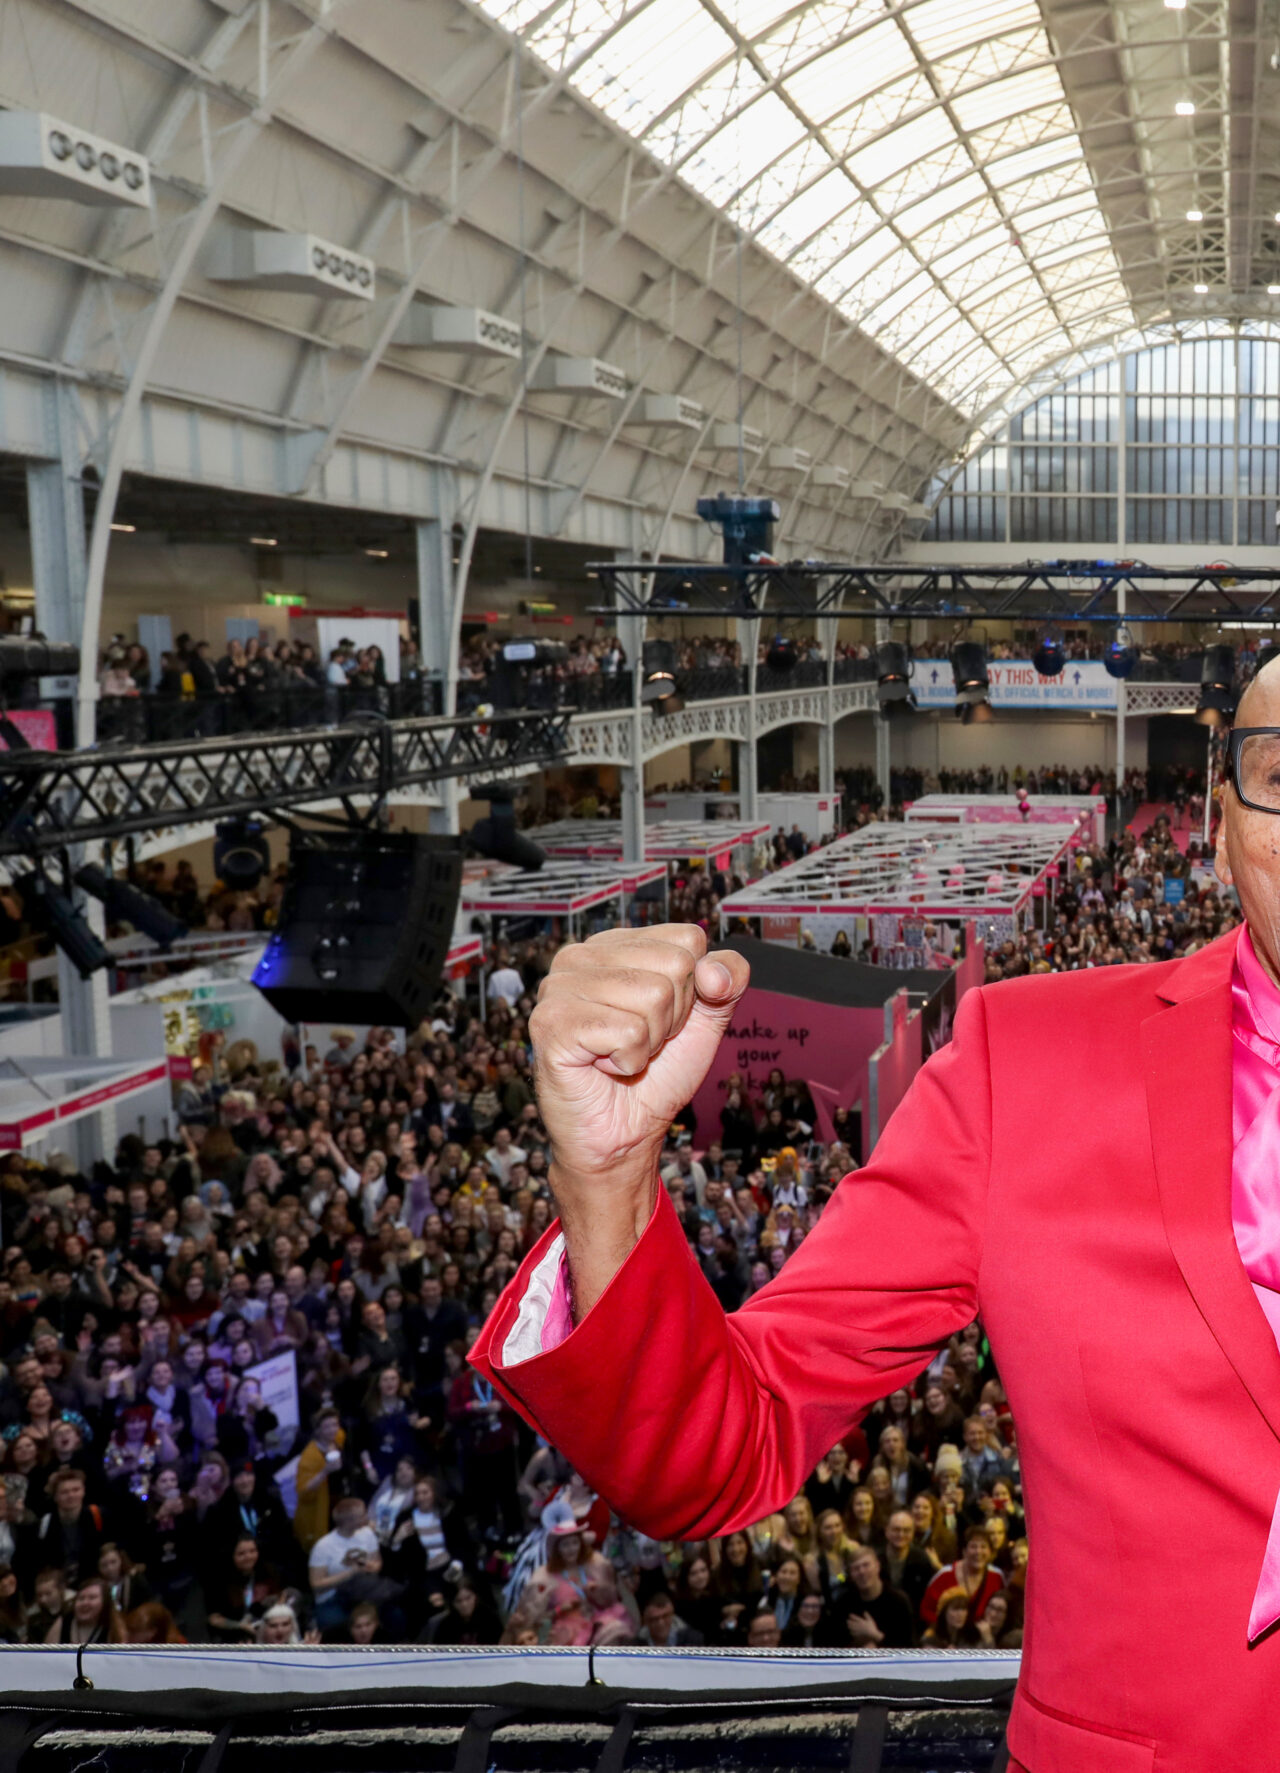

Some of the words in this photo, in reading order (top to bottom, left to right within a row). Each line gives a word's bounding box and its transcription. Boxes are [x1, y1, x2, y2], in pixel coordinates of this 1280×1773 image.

[1006, 669, 1034, 685] THIS
[1038, 669, 1065, 685] WAY
[787, 1027, 809, 1047] up
[738, 1050, 781, 1068] your
